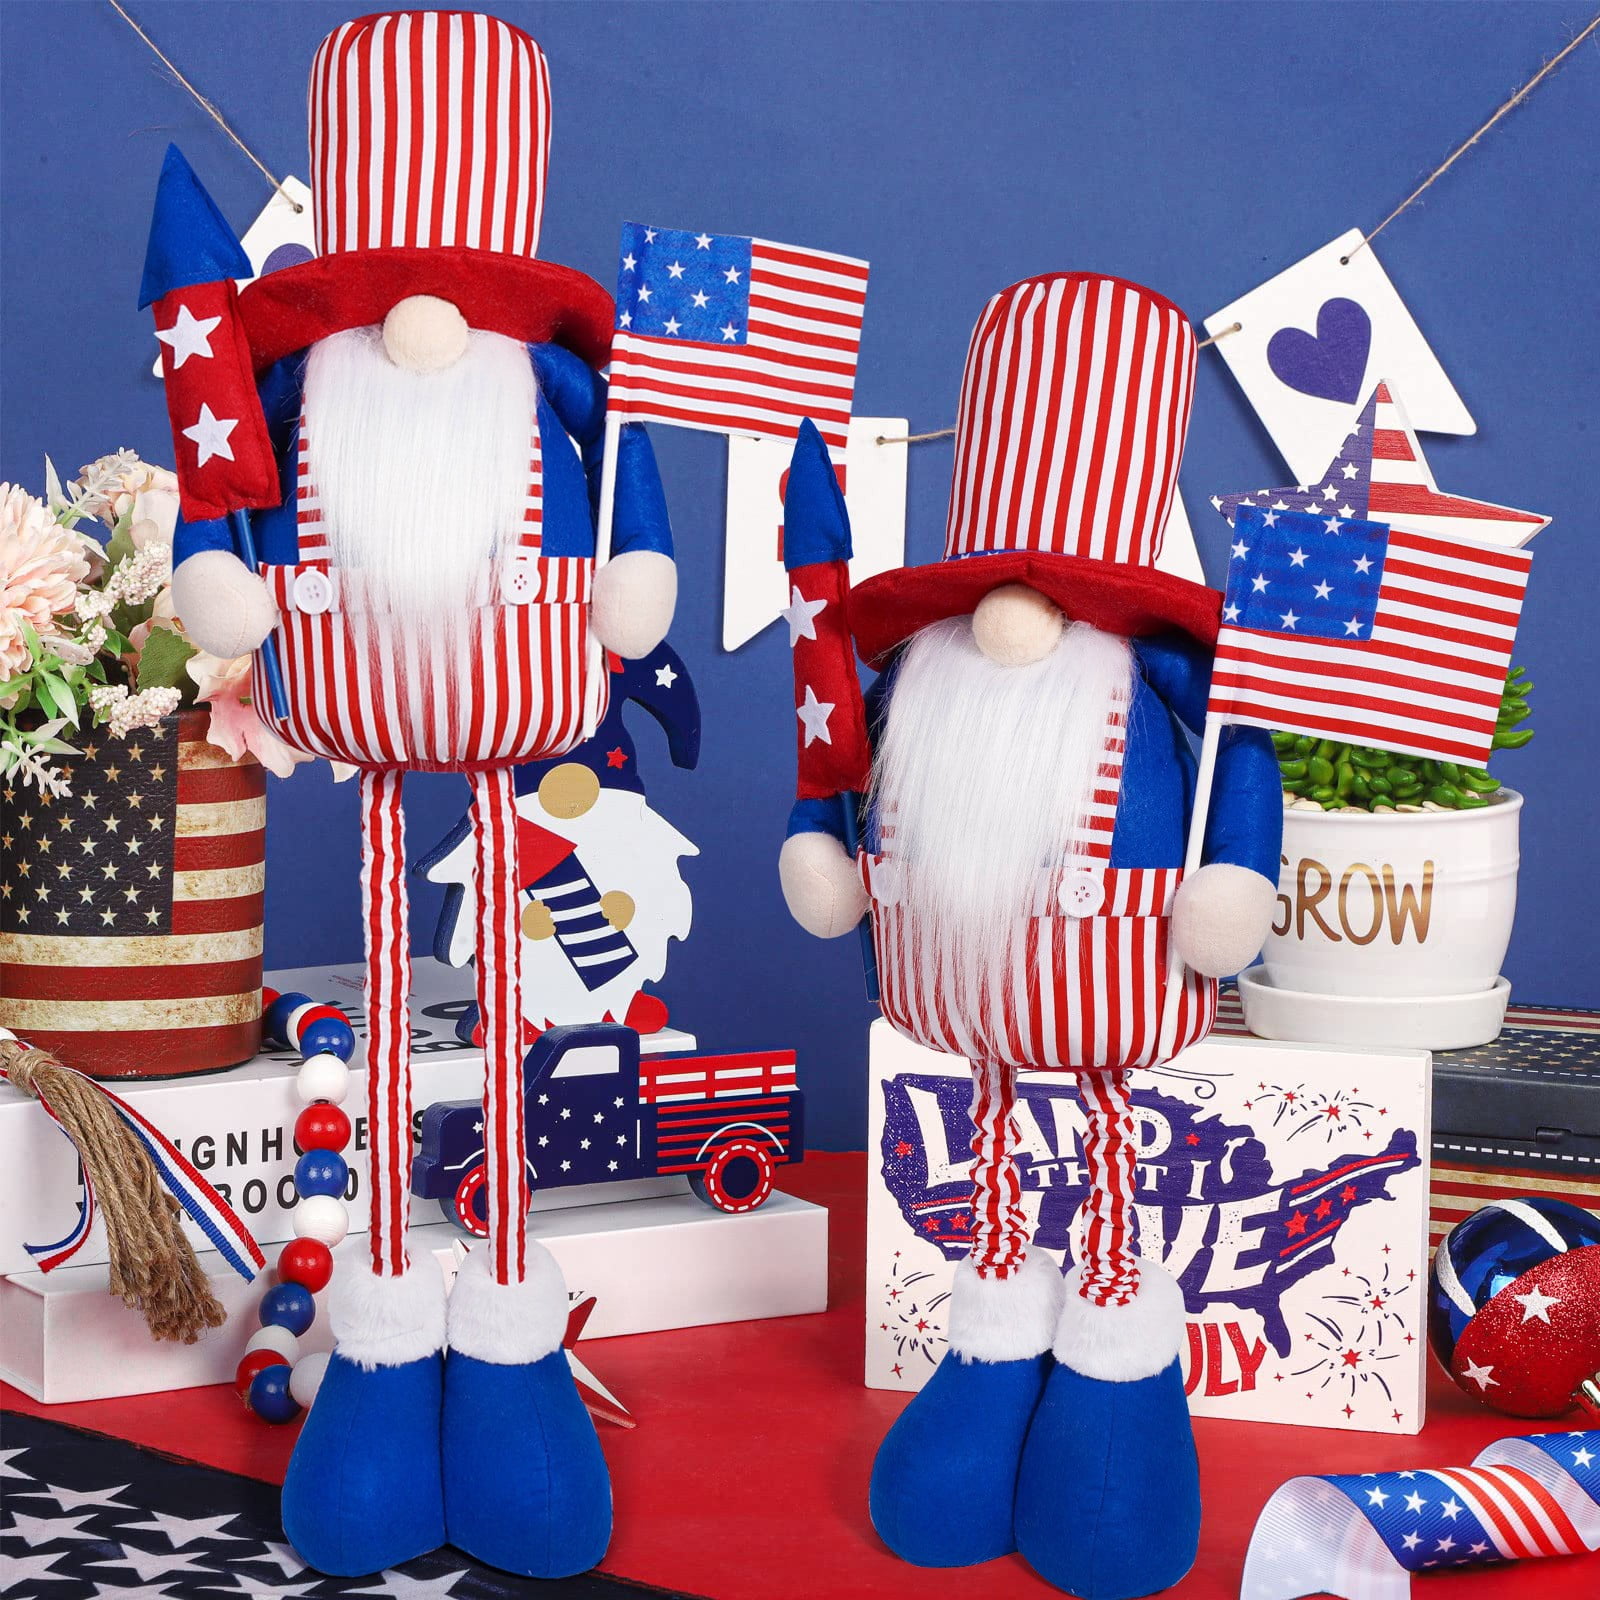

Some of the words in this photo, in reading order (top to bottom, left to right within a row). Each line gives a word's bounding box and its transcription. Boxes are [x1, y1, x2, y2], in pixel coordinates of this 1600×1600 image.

[1026, 1161, 1169, 1192] THT
[1186, 1159, 1212, 1201] I
[1012, 1187, 1285, 1294] LVE
